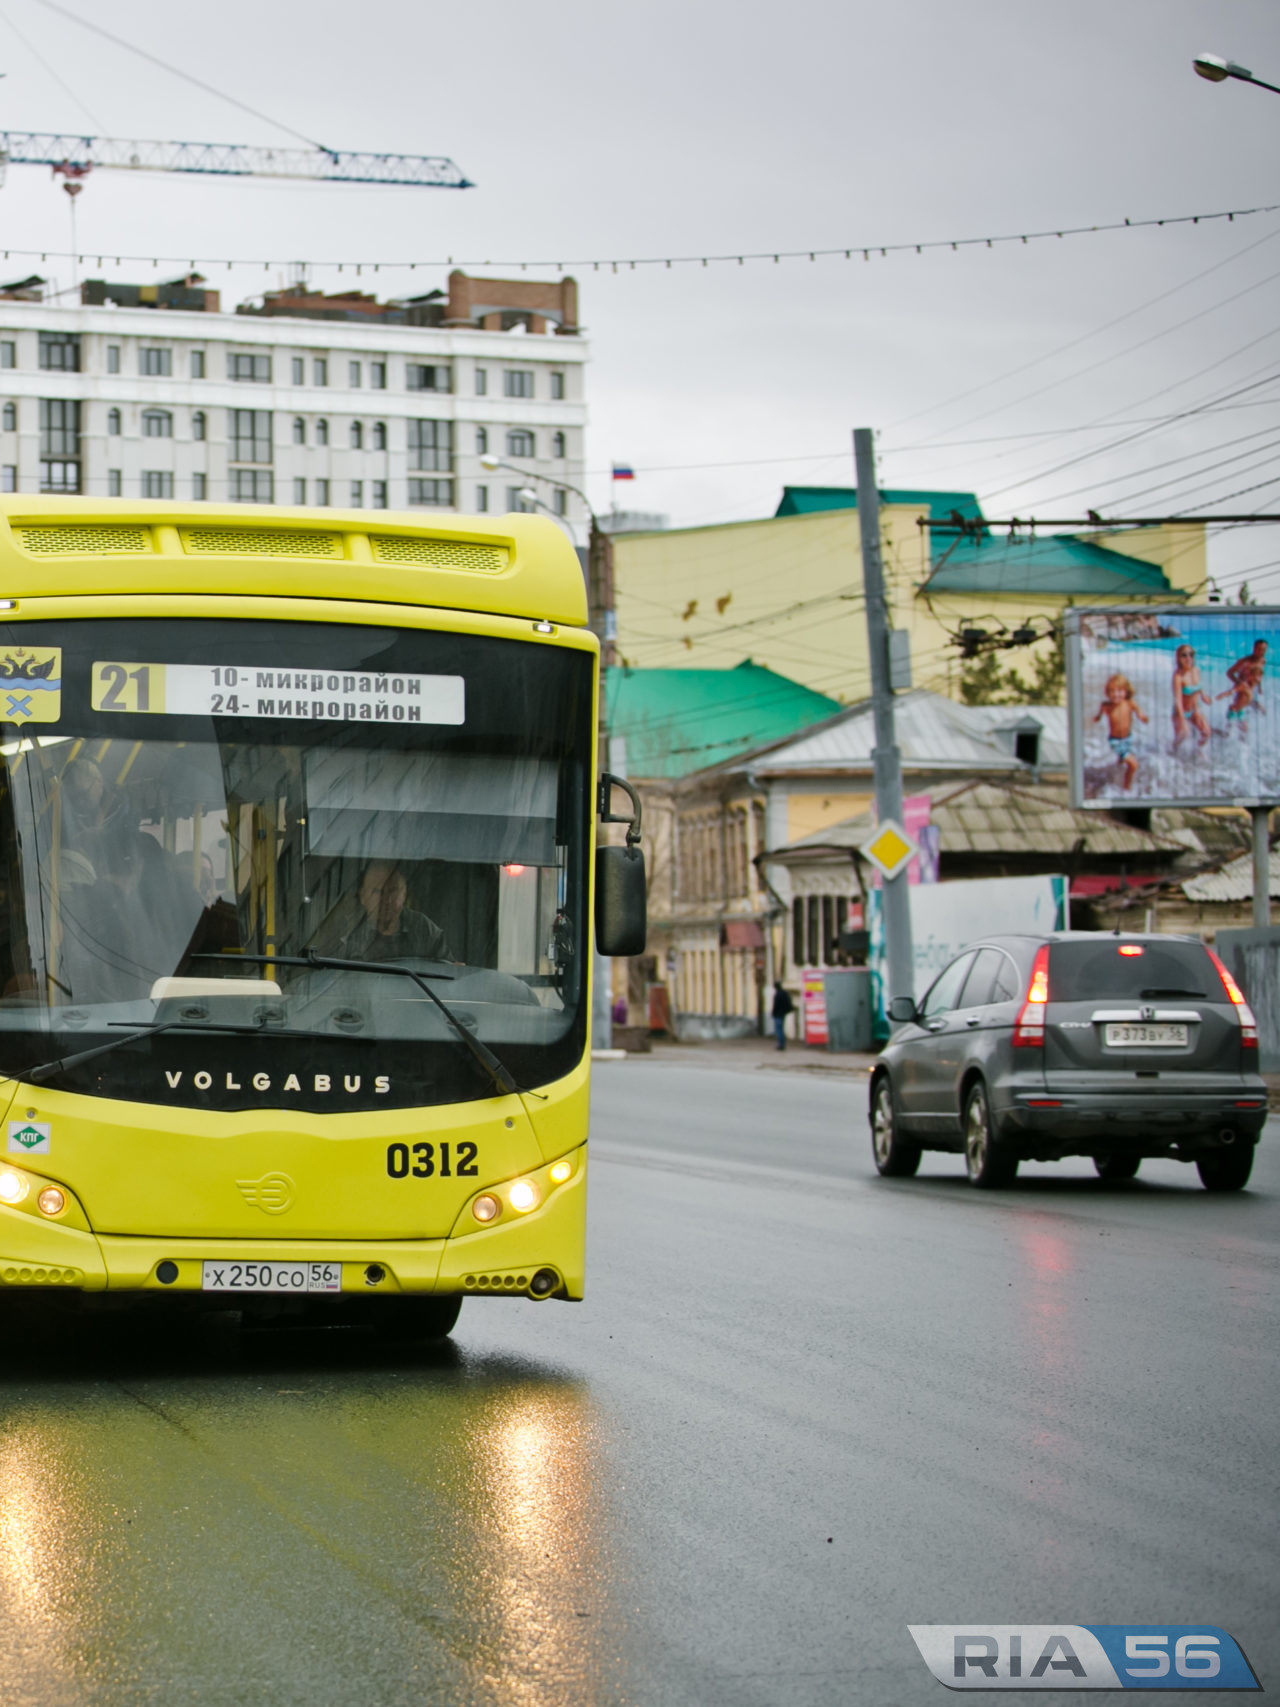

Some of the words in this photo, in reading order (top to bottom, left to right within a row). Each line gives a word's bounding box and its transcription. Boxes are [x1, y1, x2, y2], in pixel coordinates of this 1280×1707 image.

[99, 664, 150, 711] 21
[210, 667, 249, 687] 10-
[256, 672, 421, 695] микрорайон
[210, 693, 250, 714] 24-
[257, 699, 421, 721] микрорайон
[165, 1071, 390, 1093] VOLGABUS
[20, 1132, 39, 1143] КПГ
[386, 1141, 479, 1179] 0312
[312, 1264, 333, 1281] 56
